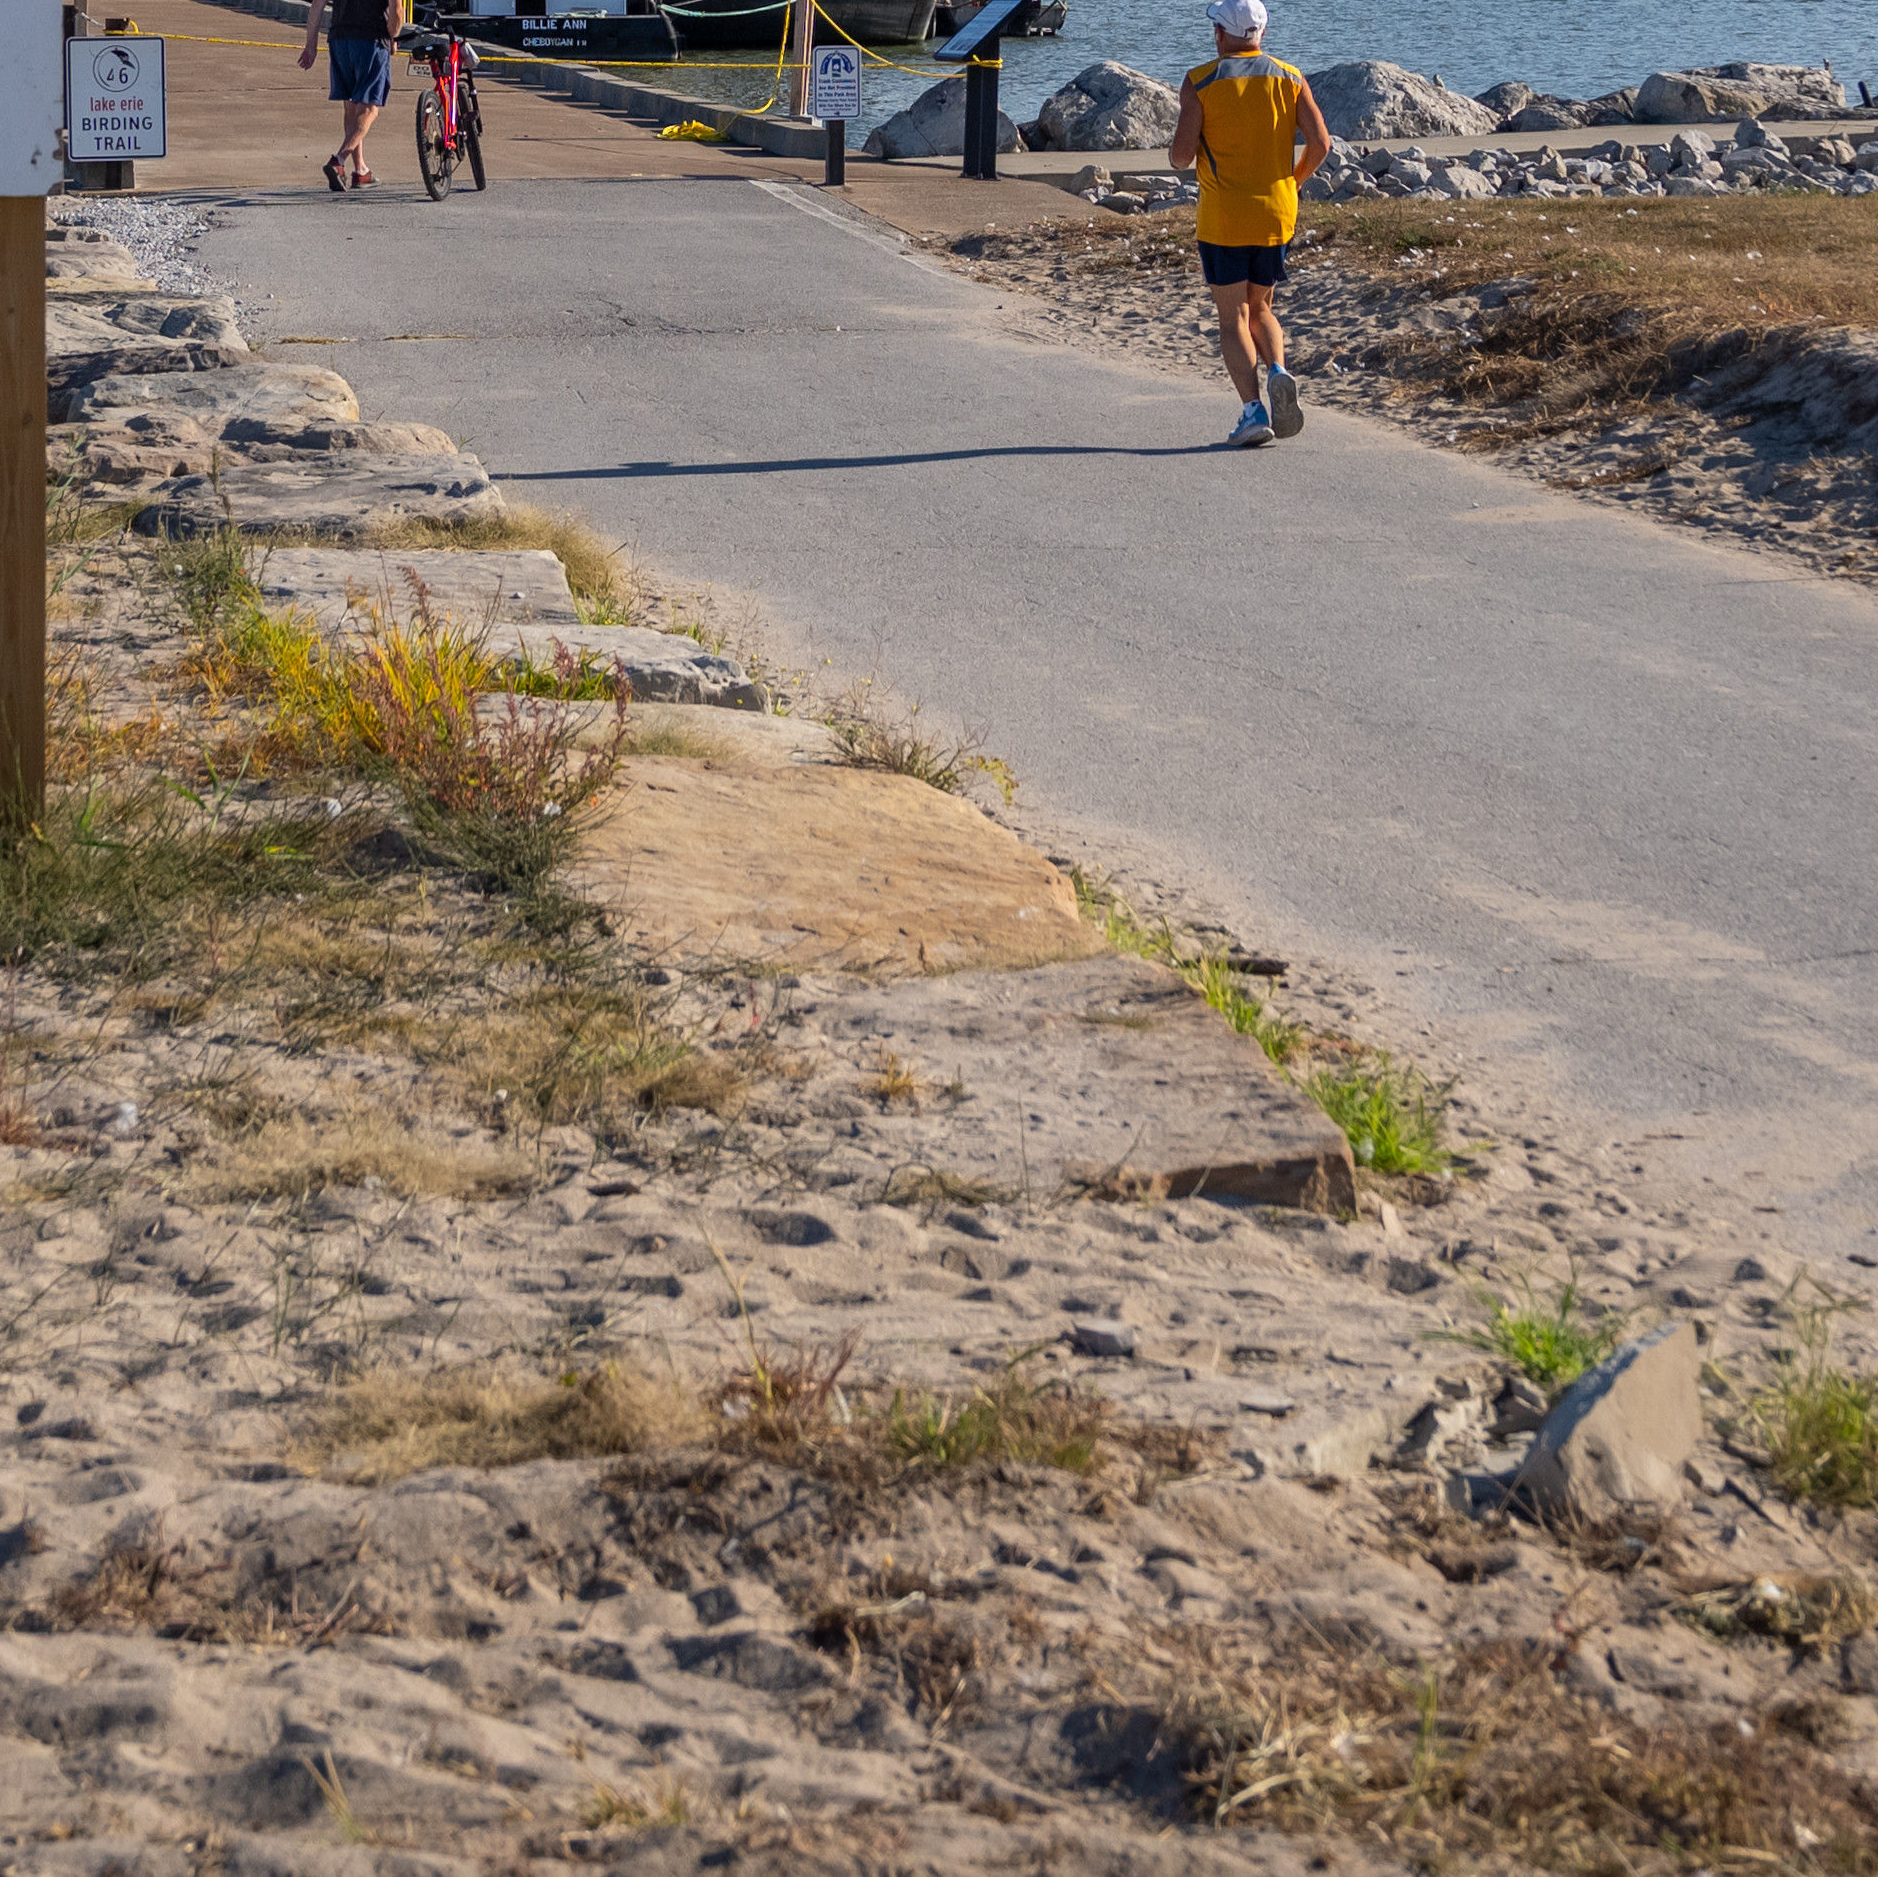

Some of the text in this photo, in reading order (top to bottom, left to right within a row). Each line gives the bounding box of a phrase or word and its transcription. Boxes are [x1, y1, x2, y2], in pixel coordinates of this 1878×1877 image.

[522, 19, 586, 29] BILLIE ANN
[90, 96, 143, 111] lake erie
[82, 117, 152, 130] BIRDING
[94, 137, 141, 150] TRAIL
